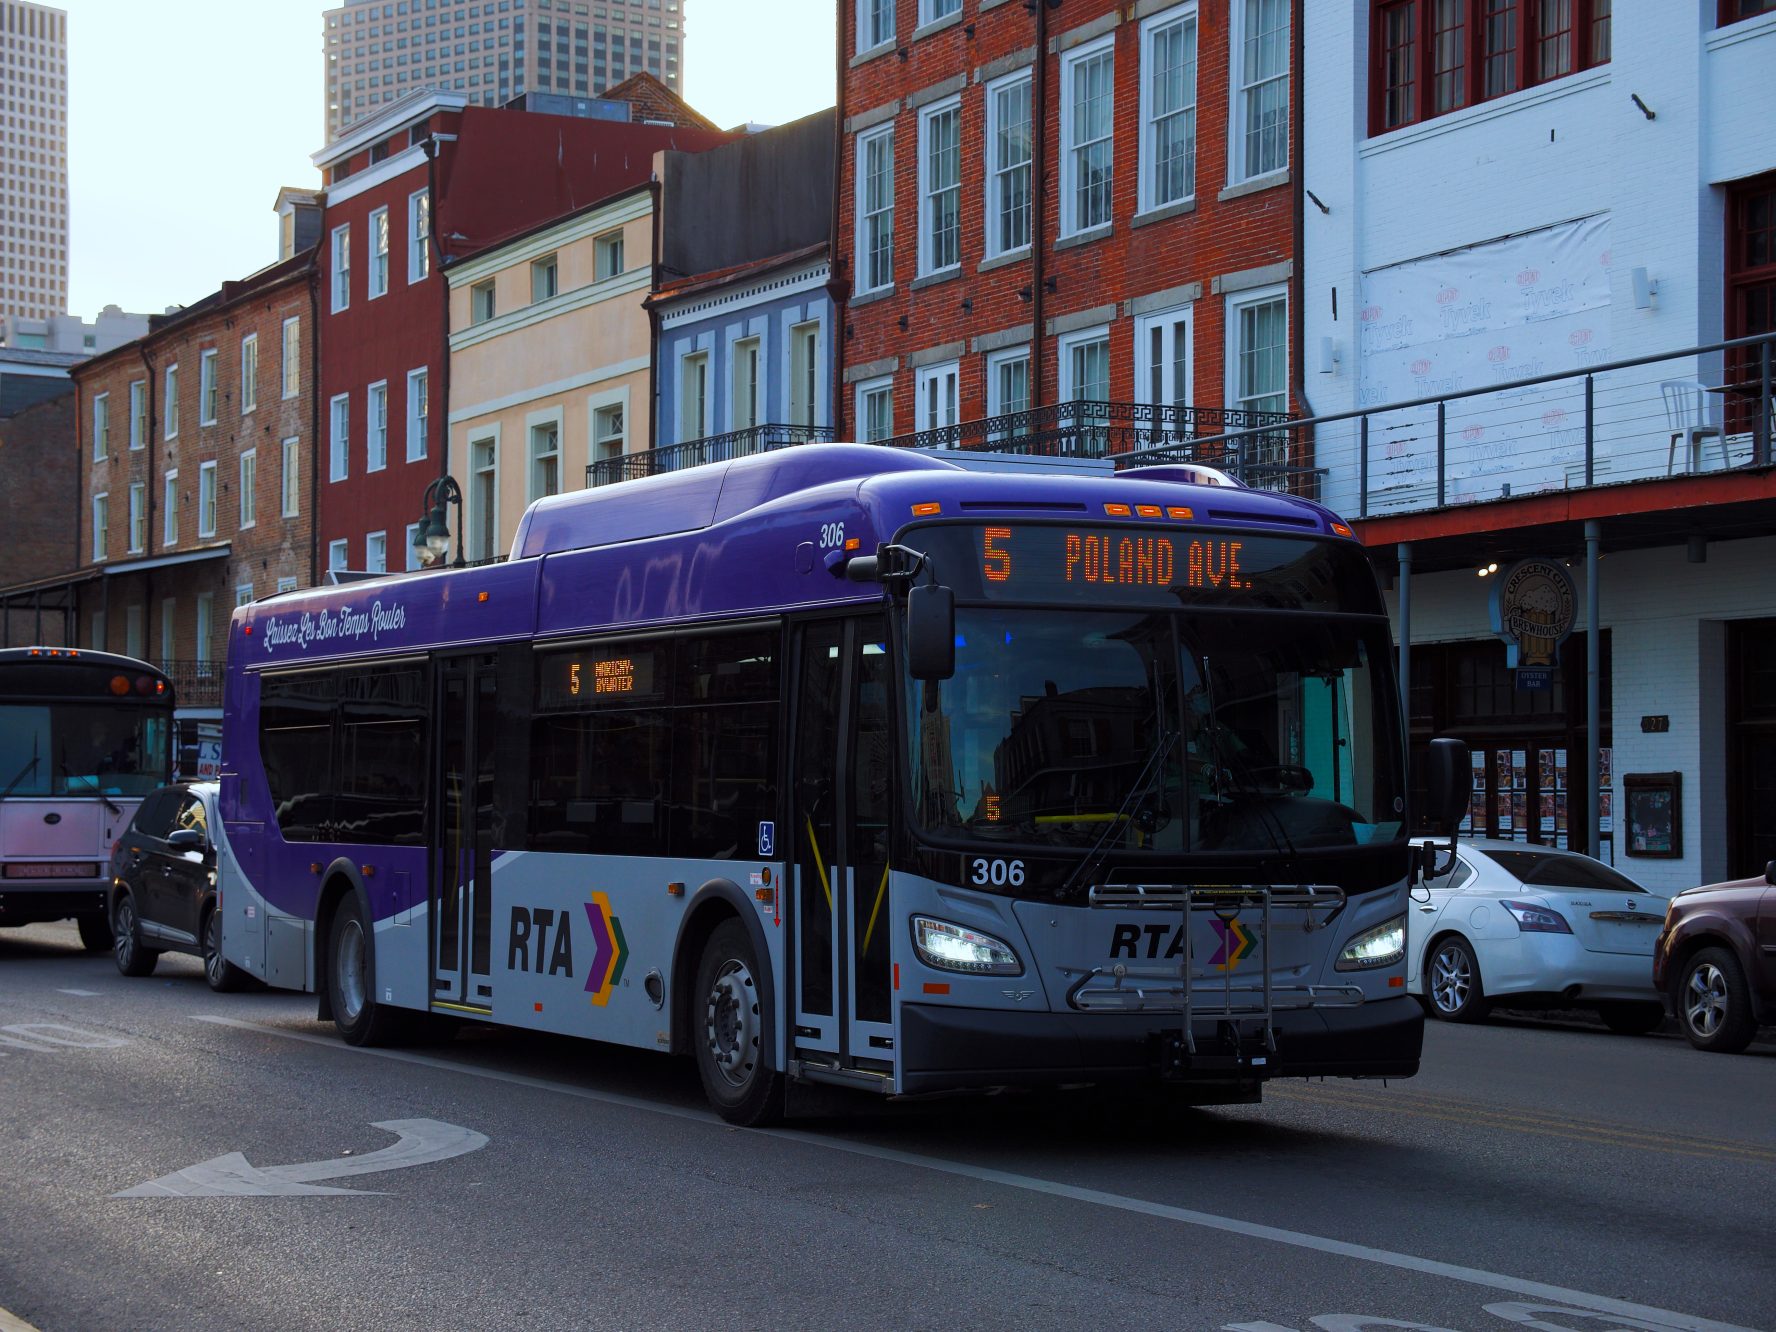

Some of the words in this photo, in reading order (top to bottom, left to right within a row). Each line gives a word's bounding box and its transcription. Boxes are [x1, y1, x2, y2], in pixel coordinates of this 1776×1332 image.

[1521, 279, 1574, 313] Tyvek
[1440, 298, 1492, 330] Tyvek
[819, 521, 845, 548] 306
[984, 528, 1011, 581] 5
[1066, 535, 1173, 585] POLAND
[1188, 541, 1252, 588] AVE.
[1508, 564, 1554, 595] CRESCENT
[1552, 571, 1571, 596] CITY
[264, 617, 298, 652] Laissez
[298, 612, 315, 649] Les
[316, 609, 338, 640] Bon
[339, 606, 369, 640] Temps
[371, 601, 405, 641] Rouler
[1513, 616, 1566, 636] BREWHOUSE
[571, 664, 580, 694] 5
[596, 676, 633, 692] BYWATER
[987, 796, 1000, 820] 5
[972, 858, 1025, 886] 306
[508, 906, 573, 978] RTA
[1109, 924, 1194, 959] RTA
